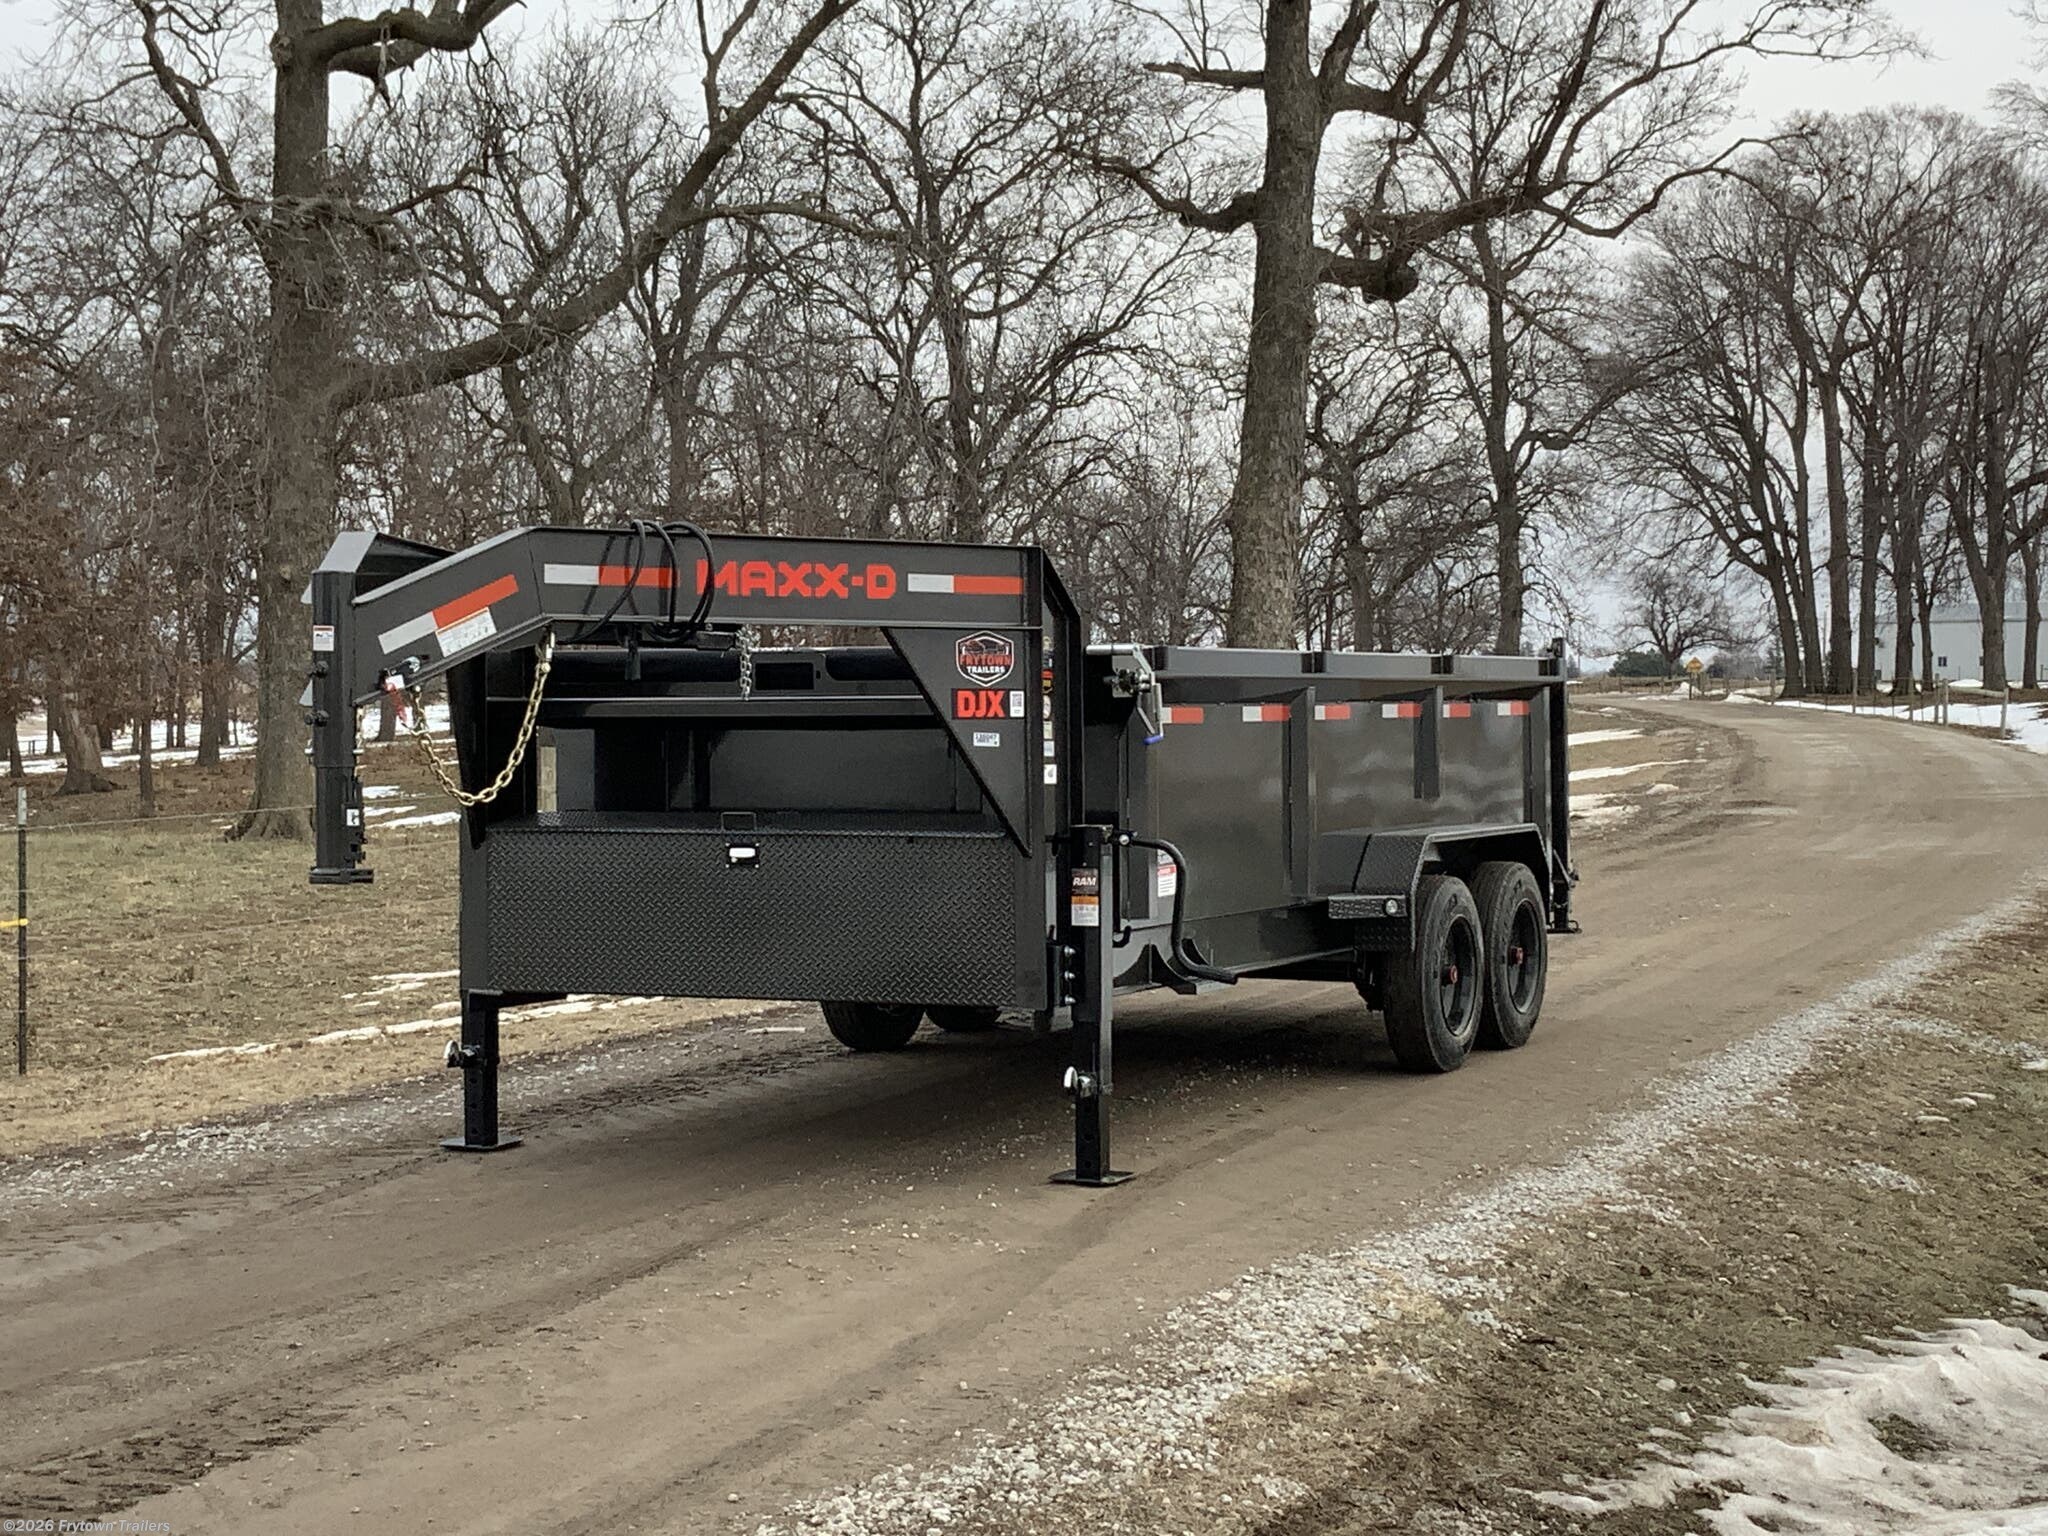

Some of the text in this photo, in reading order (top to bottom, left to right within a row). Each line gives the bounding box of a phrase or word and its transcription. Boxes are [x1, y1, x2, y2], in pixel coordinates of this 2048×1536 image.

[696, 558, 897, 600] MAXX-D
[960, 654, 1011, 666] FRYTOWN
[966, 665, 1006, 674] TRAILERS
[957, 690, 1006, 718] DJX
[1073, 877, 1097, 886] RAM
